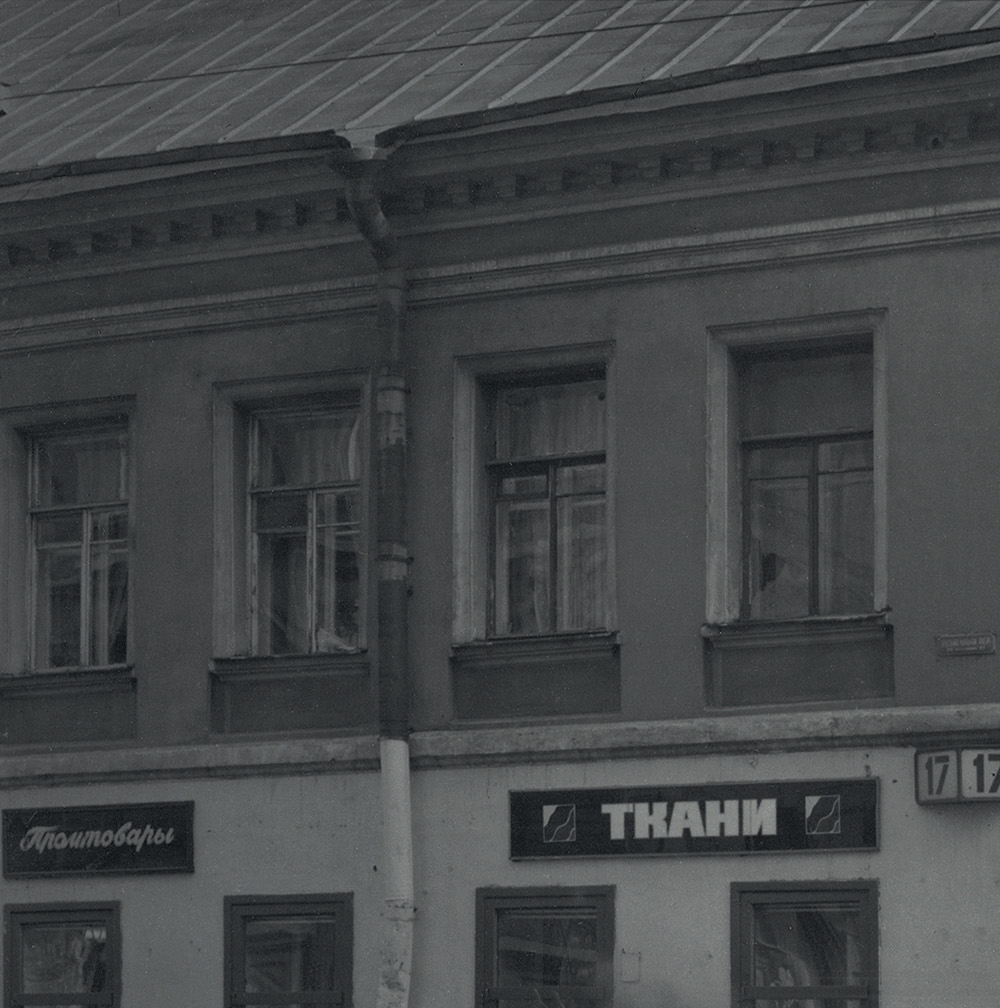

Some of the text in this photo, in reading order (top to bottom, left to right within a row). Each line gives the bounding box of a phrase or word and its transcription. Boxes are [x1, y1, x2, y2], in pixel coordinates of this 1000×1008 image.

[925, 755, 950, 795] 17
[19, 821, 175, 855] Промтовары
[601, 798, 778, 841] ТКАНИ
